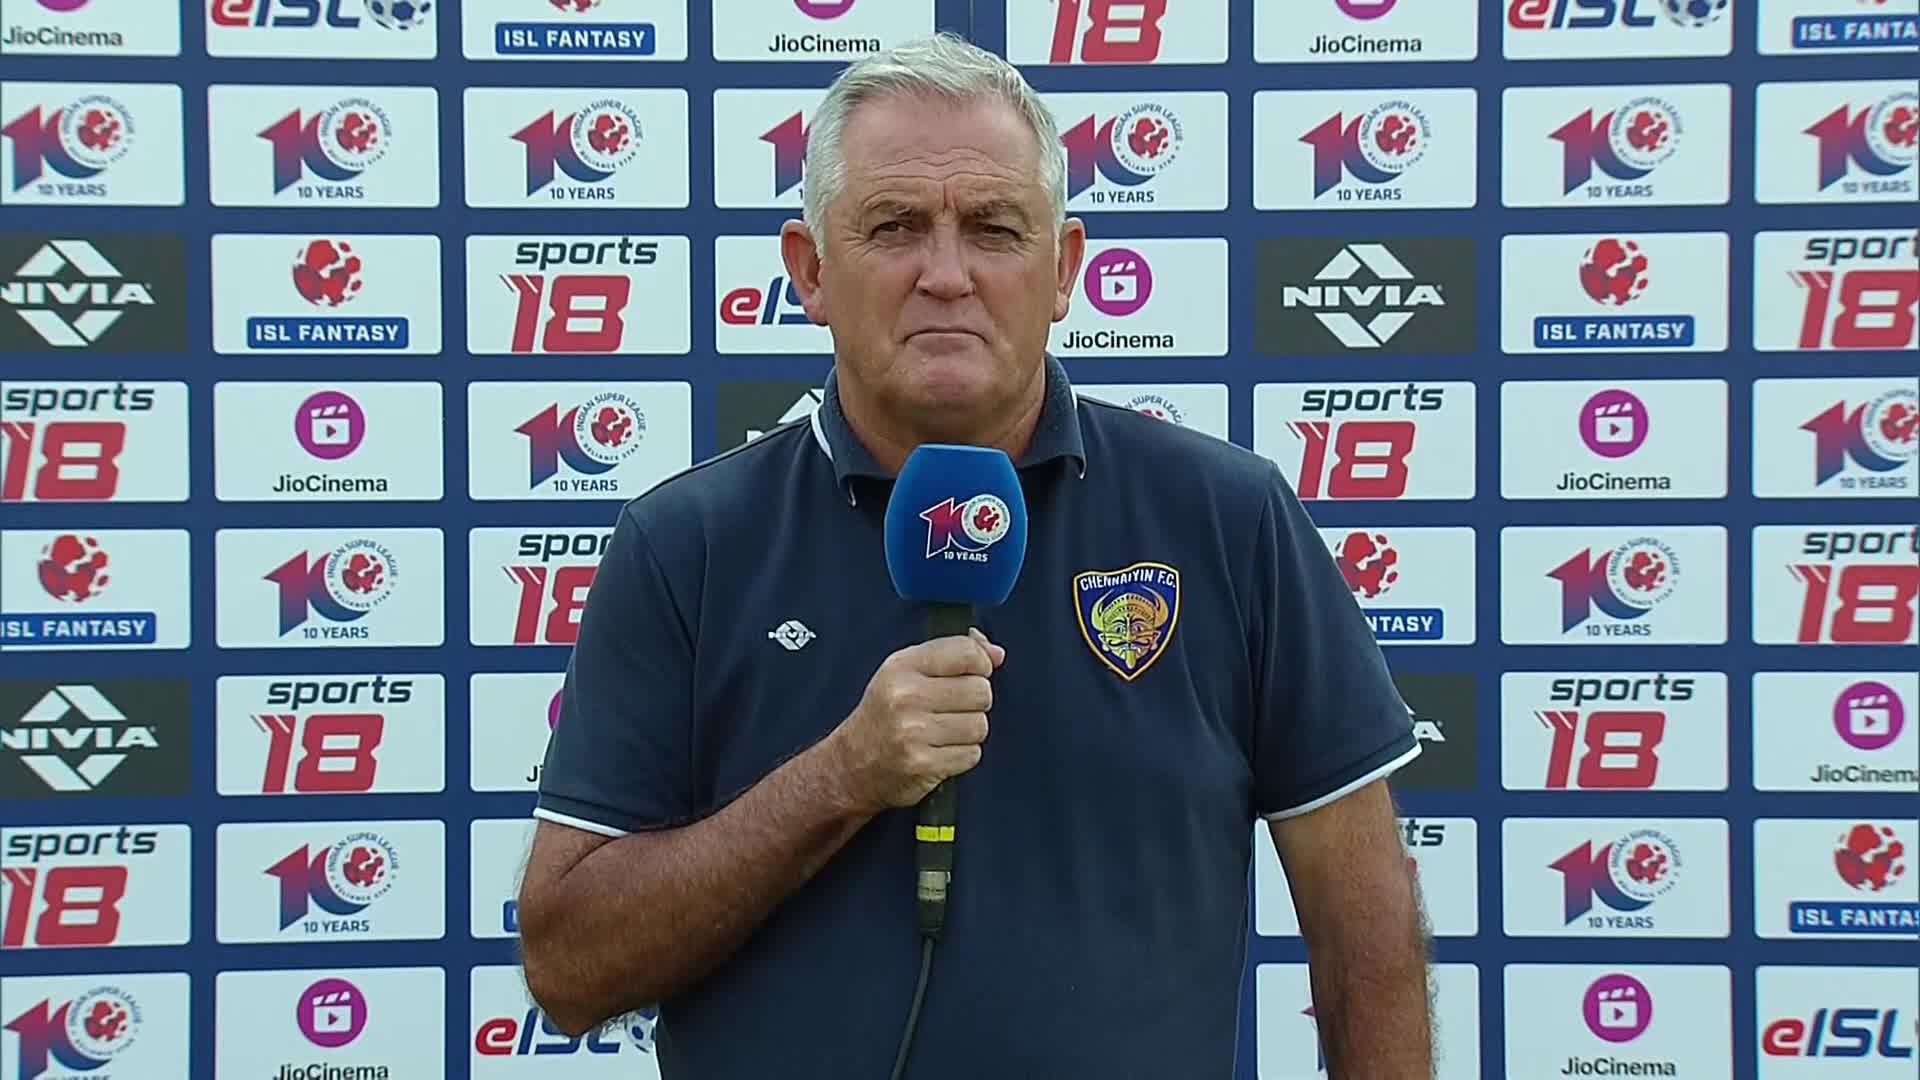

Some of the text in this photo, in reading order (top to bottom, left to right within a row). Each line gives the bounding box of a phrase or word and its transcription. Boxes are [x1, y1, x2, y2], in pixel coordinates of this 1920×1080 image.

[3, 28, 123, 47] JioCinema
[505, 30, 644, 47] ISL FANTASY
[1801, 24, 1836, 40] ISL
[769, 34, 880, 52] JioCinema
[1310, 35, 1421, 53] JioCinema
[590, 99, 622, 112] SUPER
[1131, 103, 1162, 115] SUPER
[1379, 100, 1410, 113] SUPER
[297, 186, 364, 200] 10 YEARS
[549, 187, 615, 201] 10 YEARS
[1089, 191, 1155, 204] 10 YEARS
[1336, 188, 1402, 202] 10 YEARS
[1605, 185, 1653, 199] YEARS
[516, 237, 658, 270] sports
[1283, 285, 1445, 307] NIVIA
[499, 275, 631, 352] 18
[1787, 271, 1919, 348] 18
[256, 325, 398, 341] ISL FANTASY
[1063, 331, 1173, 348] JioCinema
[1543, 323, 1685, 340] ISL FANTASY
[4, 383, 156, 417] sports
[1301, 384, 1444, 417] sports
[576, 392, 647, 432] INDIAN SUPER LEAGUE
[0, 421, 126, 500] 18
[1286, 421, 1416, 498] 18
[273, 475, 387, 492] JioCinema
[553, 480, 618, 492] 10 YEARS
[1557, 472, 1670, 490] JioCinema
[345, 539, 377, 551] SUPER
[944, 551, 988, 562] 10 YEARS
[1080, 569, 1176, 591] CHENNAIYIN F.C.
[1786, 564, 1919, 643] 18
[43, 620, 146, 636] FANTASY
[302, 627, 369, 640] 10 YEARS
[1585, 624, 1652, 637] 10 YEARS
[267, 675, 413, 710] sports
[1550, 673, 1695, 706] sports
[0, 727, 159, 748] NIVIA
[252, 714, 384, 793] 18
[1535, 711, 1666, 788] 18
[7, 826, 158, 862] sports
[0, 866, 128, 947] 18
[1587, 916, 1654, 930] 10 YEARS
[1798, 909, 1833, 925] ISL
[302, 920, 370, 934] 10 YEARS
[1763, 1009, 1913, 1057] eISL
[273, 1062, 389, 1080] JioCinema
[1562, 1057, 1675, 1075] JioCinema
